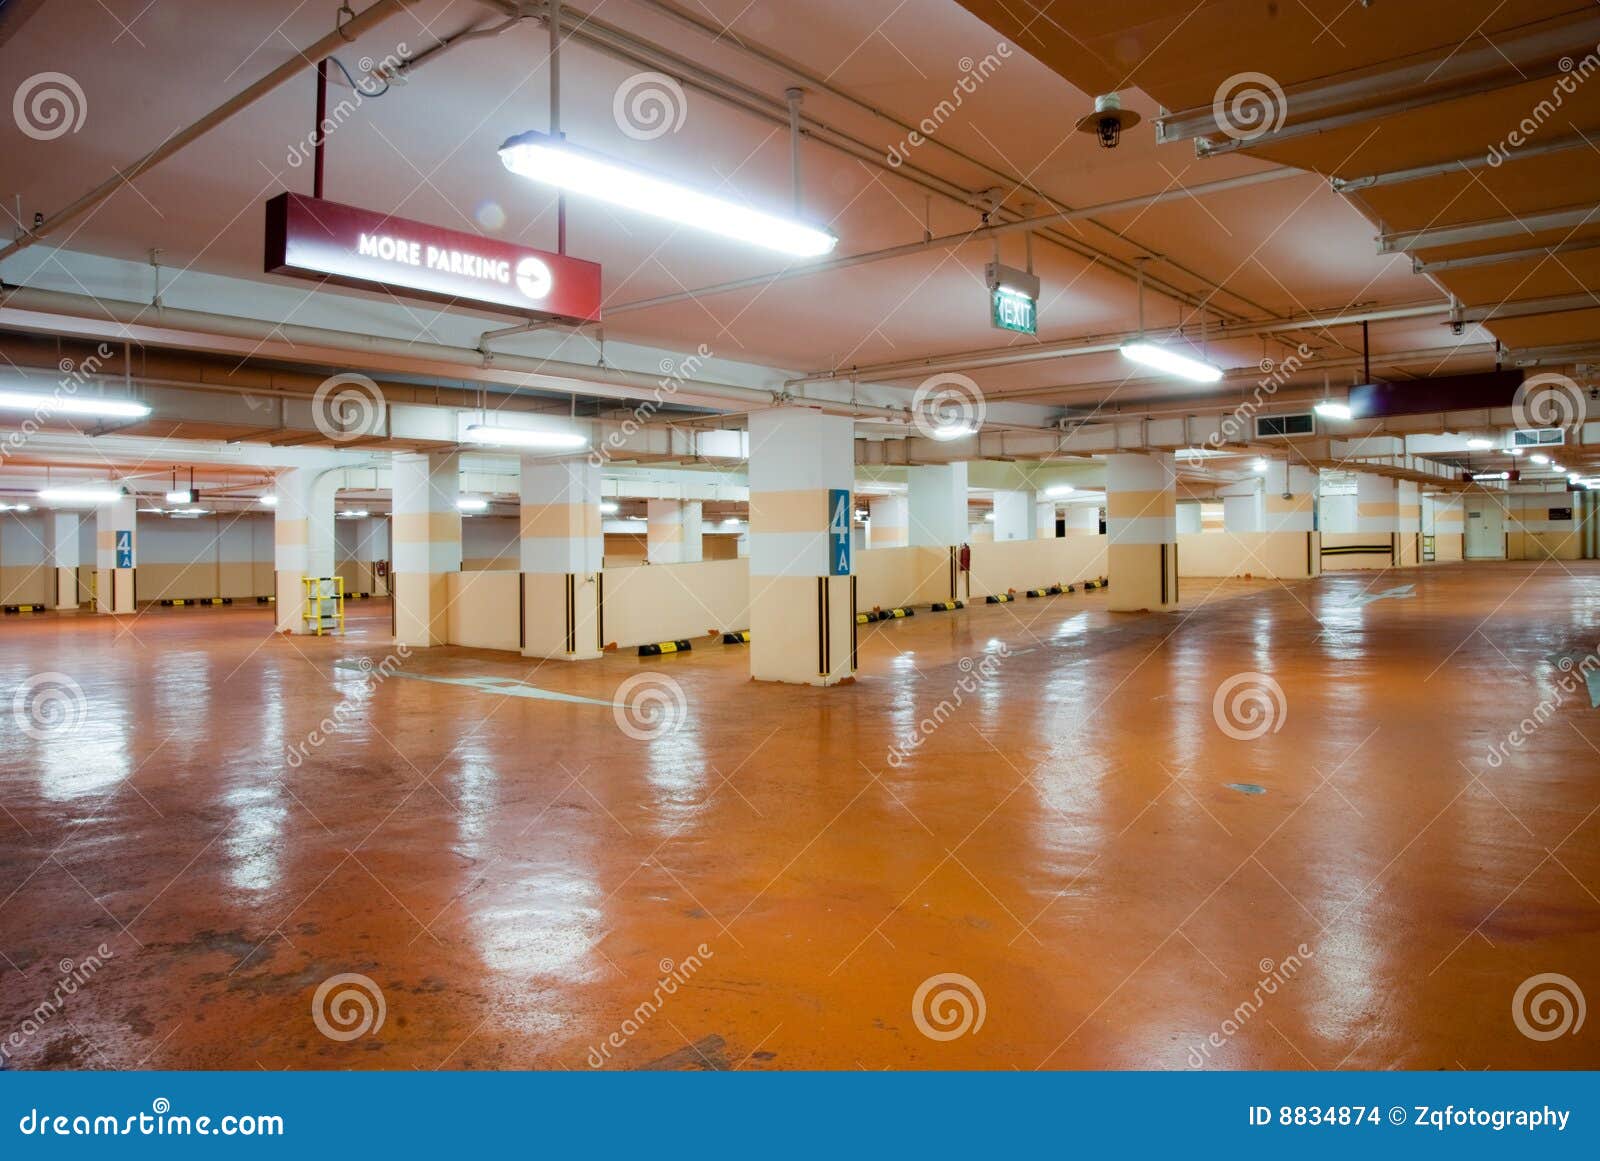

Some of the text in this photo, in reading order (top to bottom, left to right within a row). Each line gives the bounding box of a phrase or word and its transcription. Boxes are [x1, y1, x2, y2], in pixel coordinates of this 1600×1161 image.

[358, 232, 510, 284] MORE PARKING
[1005, 298, 1032, 329] EXIT
[830, 495, 848, 544] 4
[117, 532, 130, 554] 4
[122, 557, 130, 567] A
[838, 549, 848, 571] A
